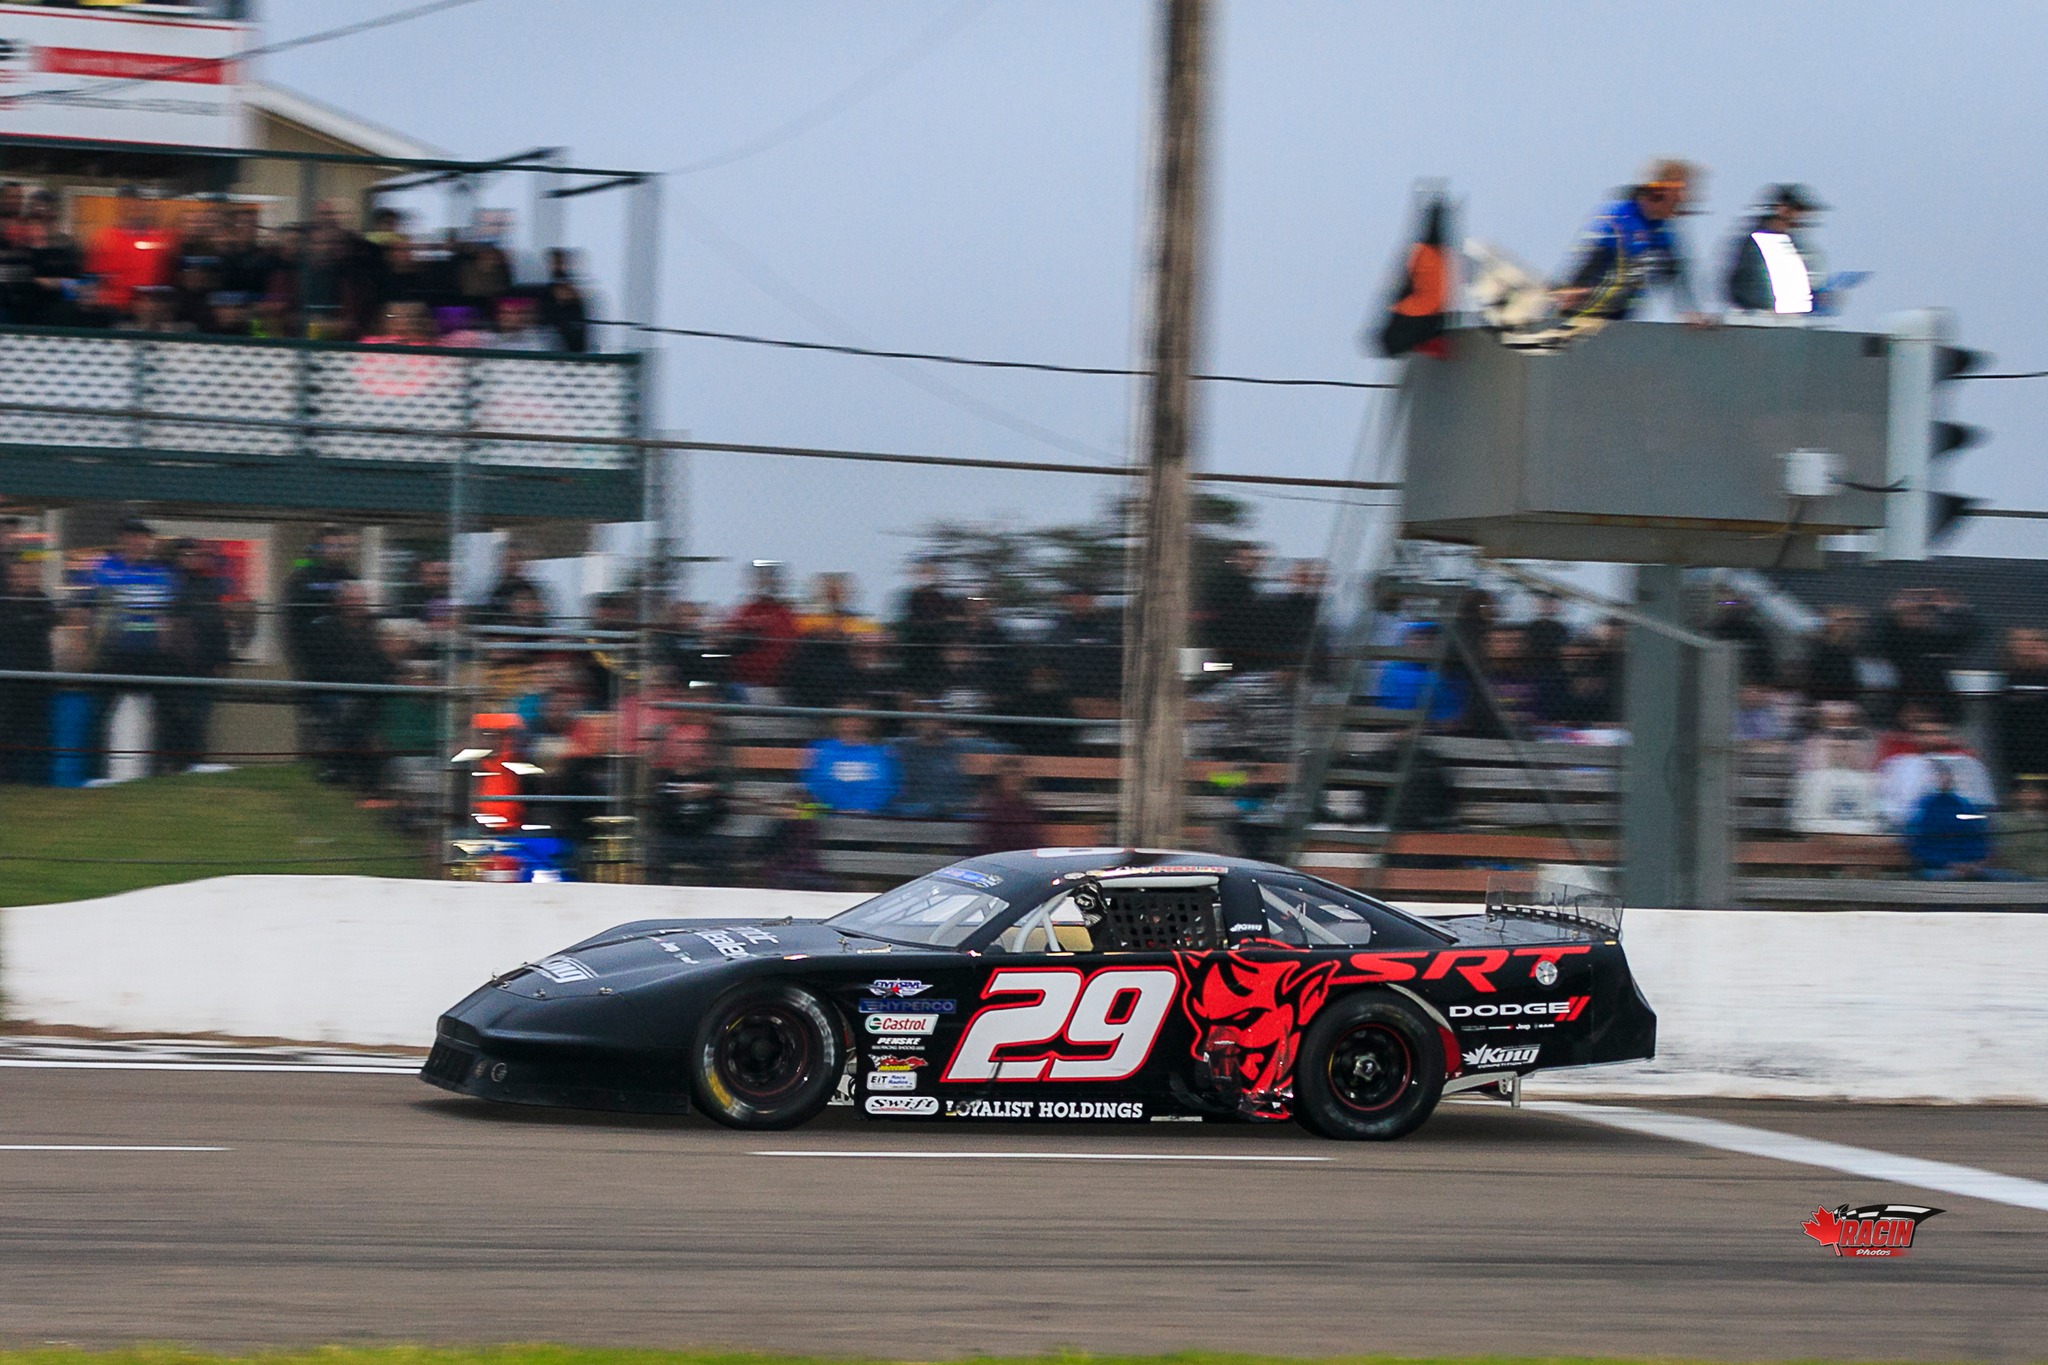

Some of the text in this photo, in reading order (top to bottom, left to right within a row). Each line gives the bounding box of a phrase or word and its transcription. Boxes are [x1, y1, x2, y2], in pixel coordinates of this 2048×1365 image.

[1327, 945, 1592, 993] SRT
[880, 1001, 954, 1012] HYPERCO
[1449, 1001, 1571, 1018] DODGE
[882, 1017, 927, 1031] Castrol
[939, 965, 1180, 1083] 29
[877, 1037, 922, 1046] PENSKE
[871, 1098, 934, 1110] Swift
[945, 1099, 1144, 1119] LOYALIST HOLDINGS
